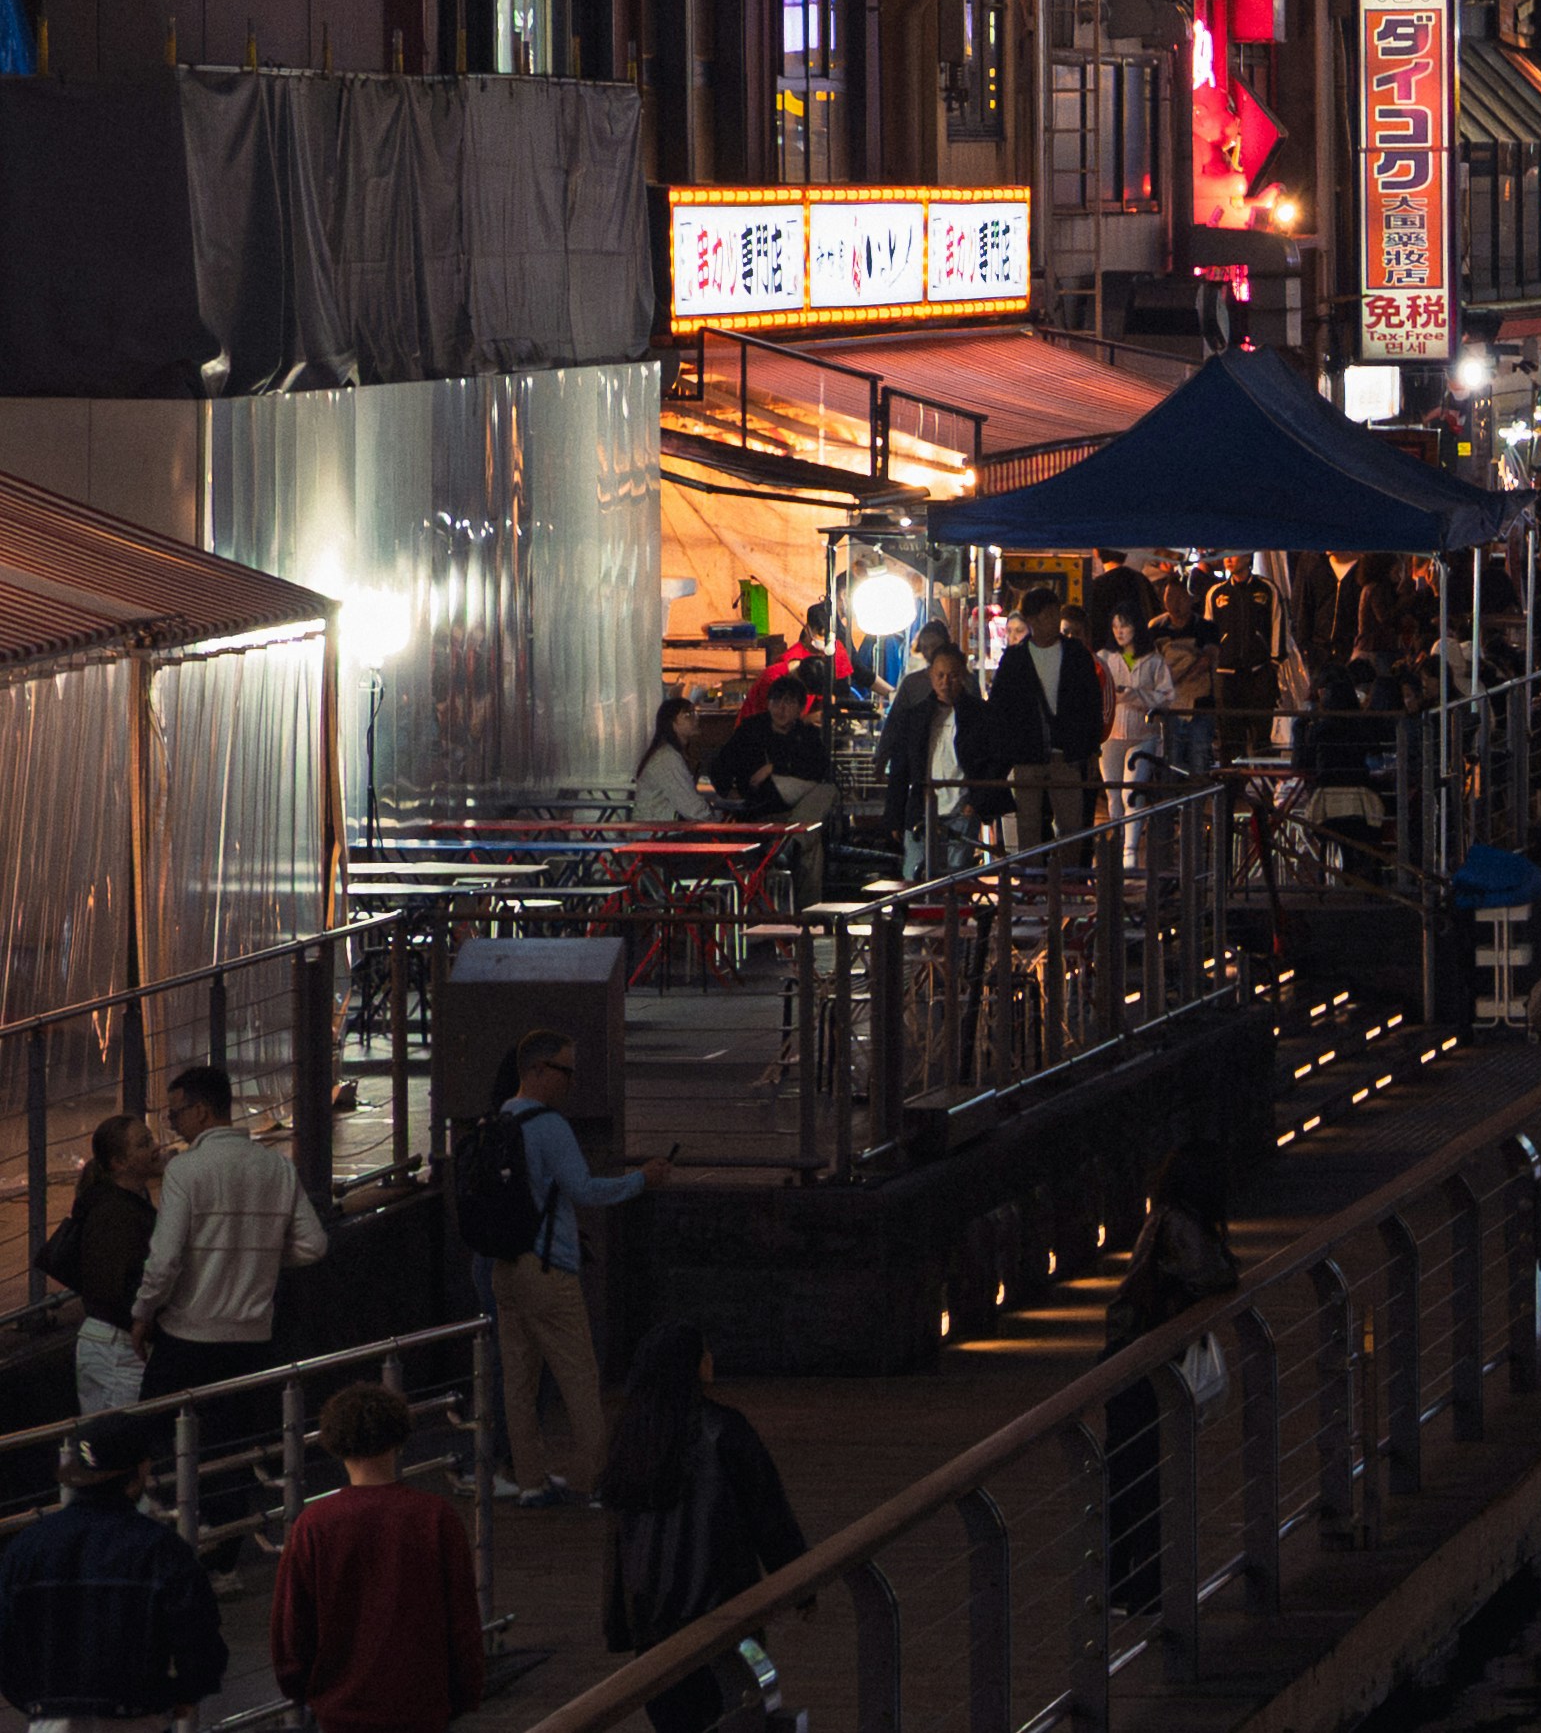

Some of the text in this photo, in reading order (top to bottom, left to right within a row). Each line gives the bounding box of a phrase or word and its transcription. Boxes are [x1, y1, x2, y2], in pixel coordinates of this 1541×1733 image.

[1373, 12, 1433, 193] ダイコク
[1364, 294, 1447, 330] 免税
[1367, 330, 1445, 342] Tax-Free
[1384, 341, 1427, 355] 면세
